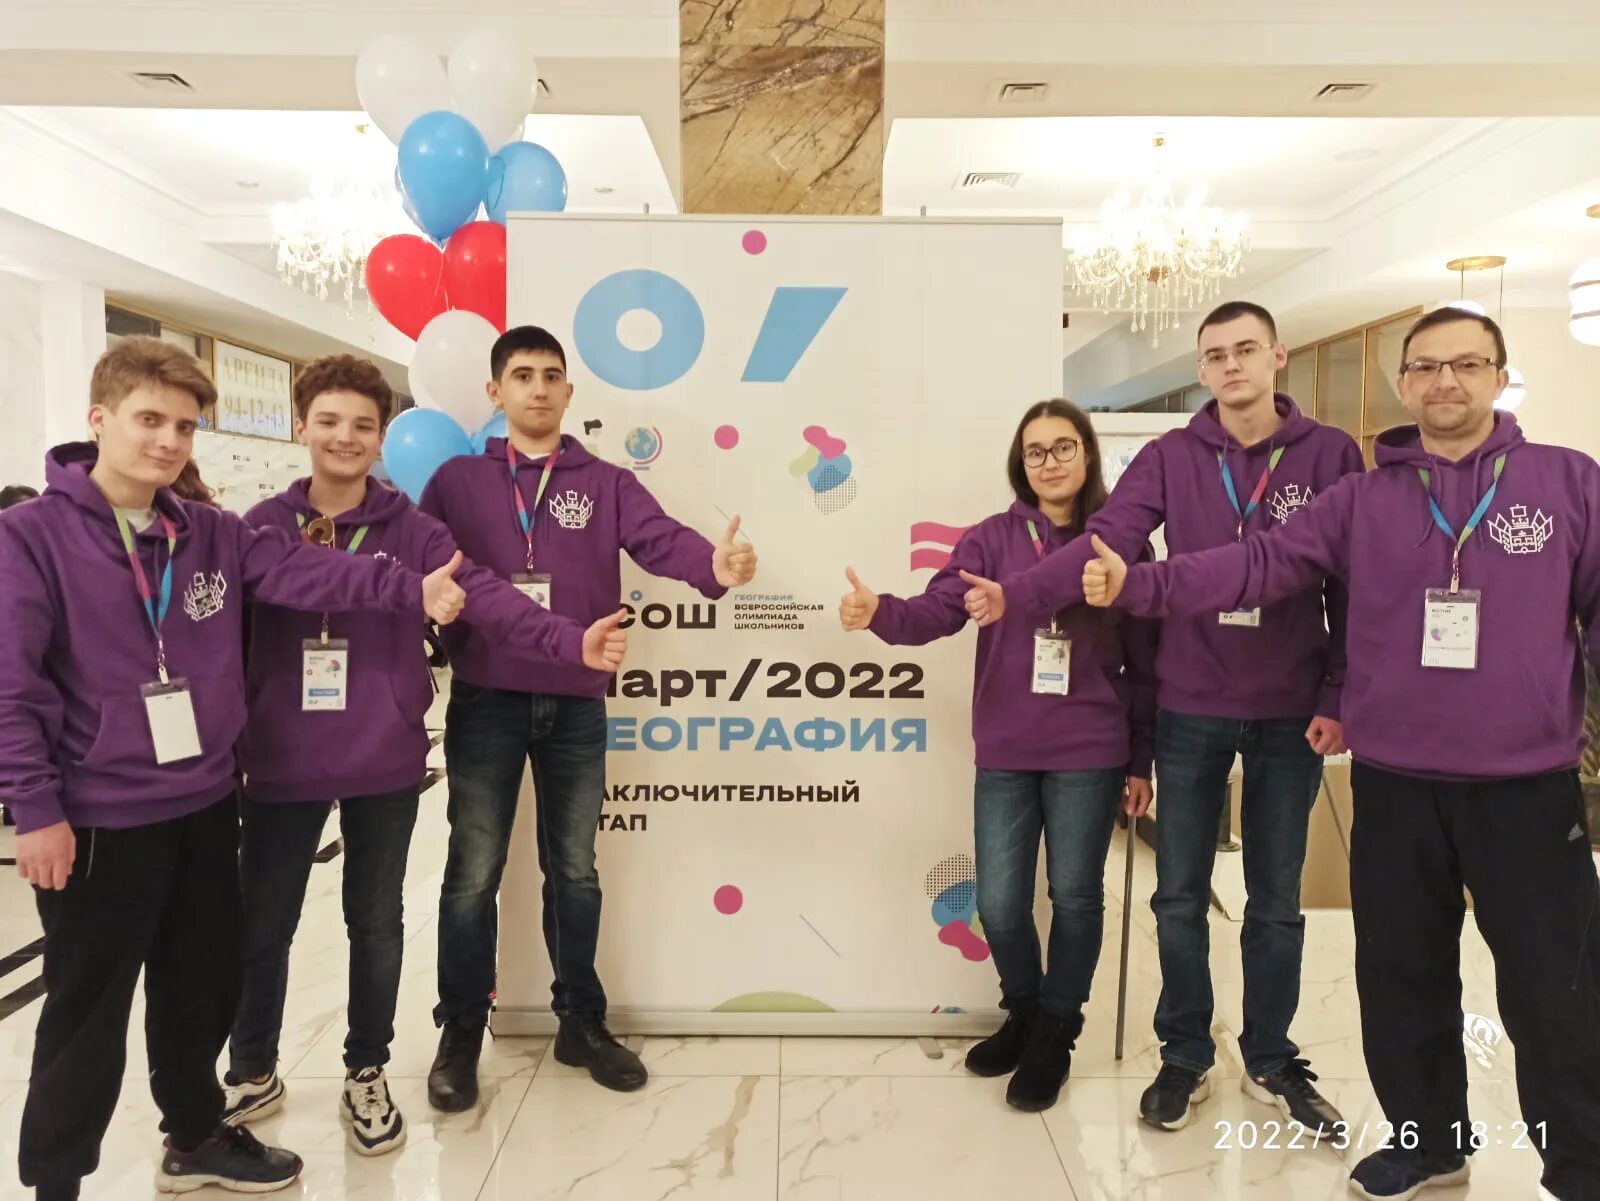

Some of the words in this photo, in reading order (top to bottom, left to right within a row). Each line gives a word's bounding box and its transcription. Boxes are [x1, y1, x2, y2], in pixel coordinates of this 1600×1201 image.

[734, 602, 824, 611] ВСЕРОССИЙСКАЯ
[618, 603, 717, 630] СОШ
[734, 613, 798, 621] ОЛИМПИАДА
[606, 716, 927, 752] ЕОГРАФИЯ
[603, 780, 860, 802] КЛЮЧИТЕЛЬНЫЙ
[599, 814, 647, 831] ТАП
